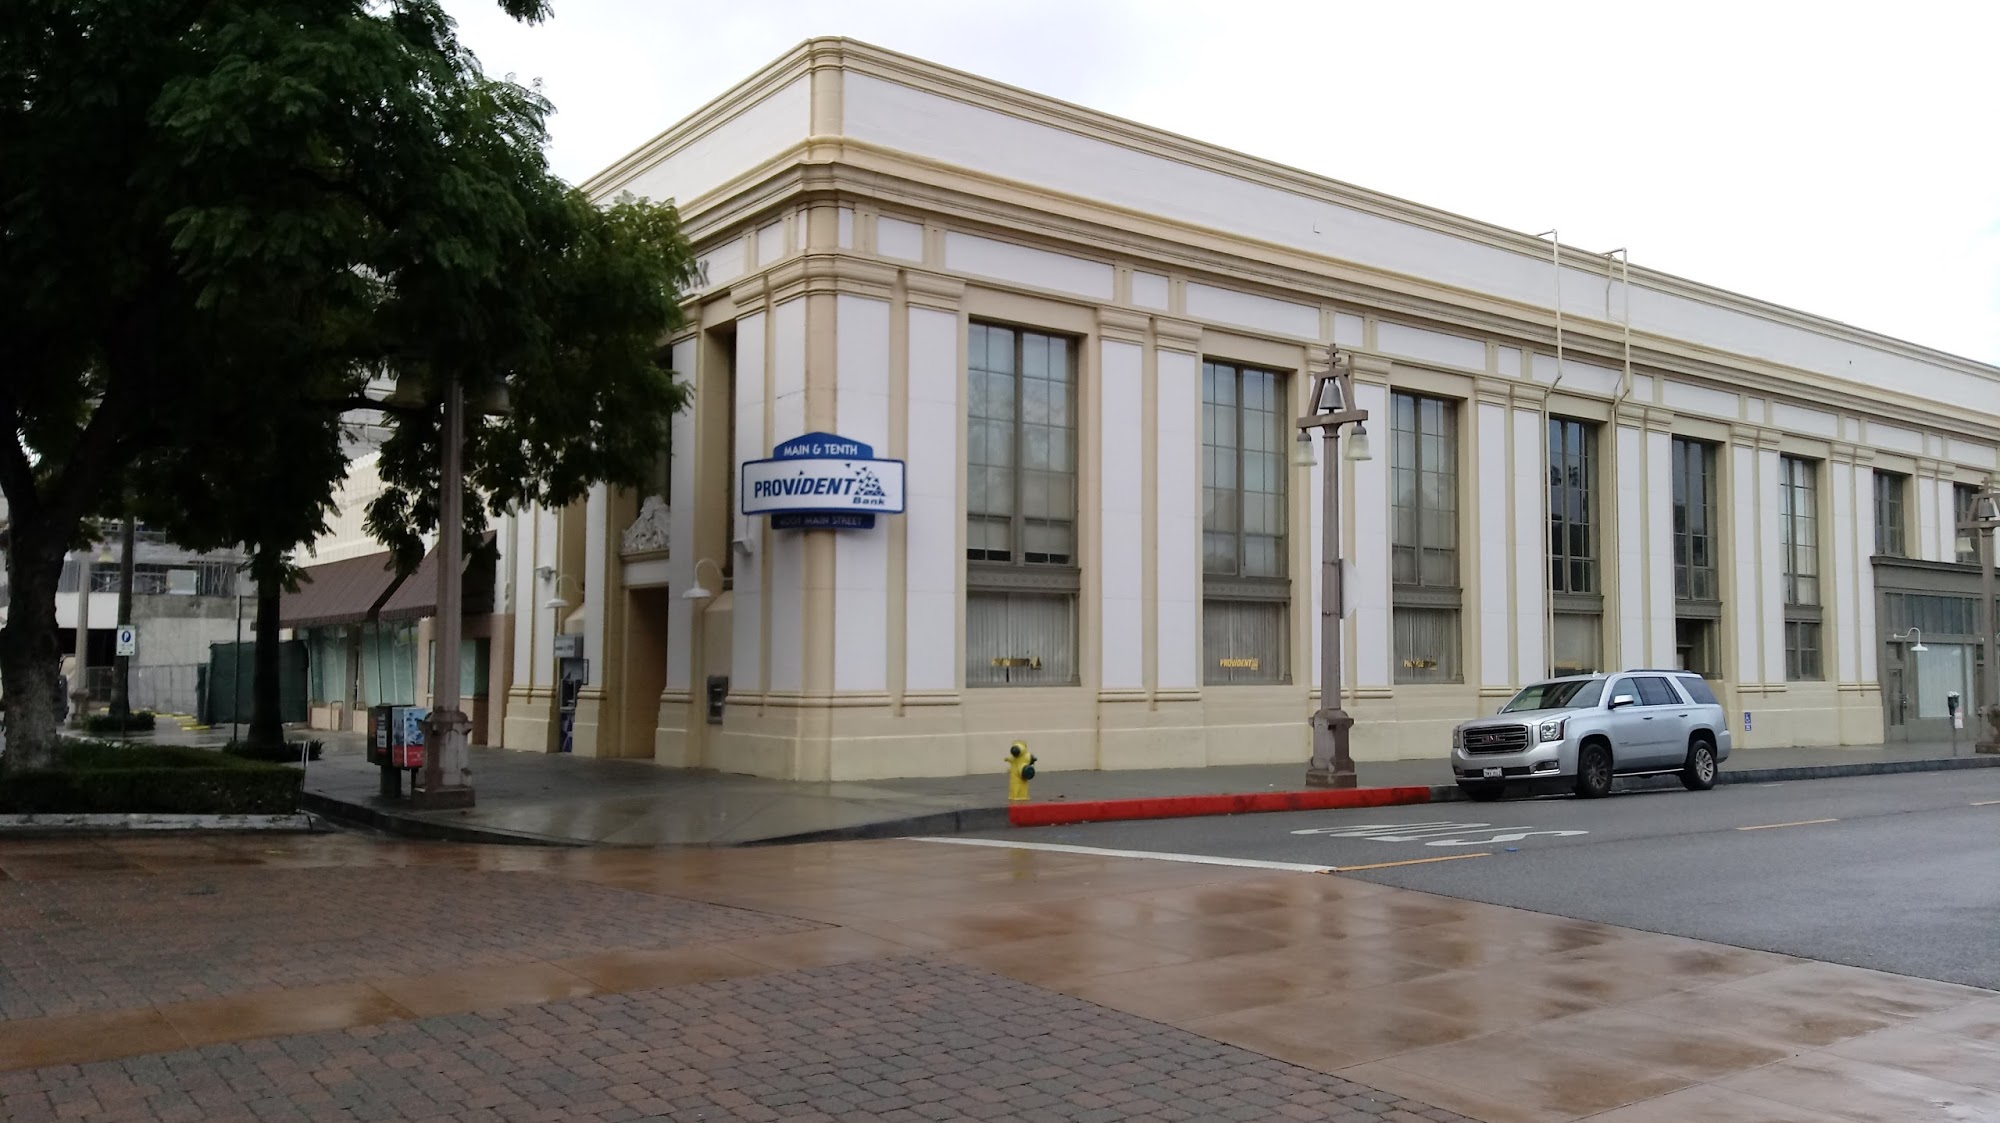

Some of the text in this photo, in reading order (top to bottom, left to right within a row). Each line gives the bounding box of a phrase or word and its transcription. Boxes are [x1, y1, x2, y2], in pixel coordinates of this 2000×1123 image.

[783, 444, 857, 456] MAIN & TENTH
[754, 475, 856, 499] PROVIDENT
[852, 497, 885, 505] Bank
